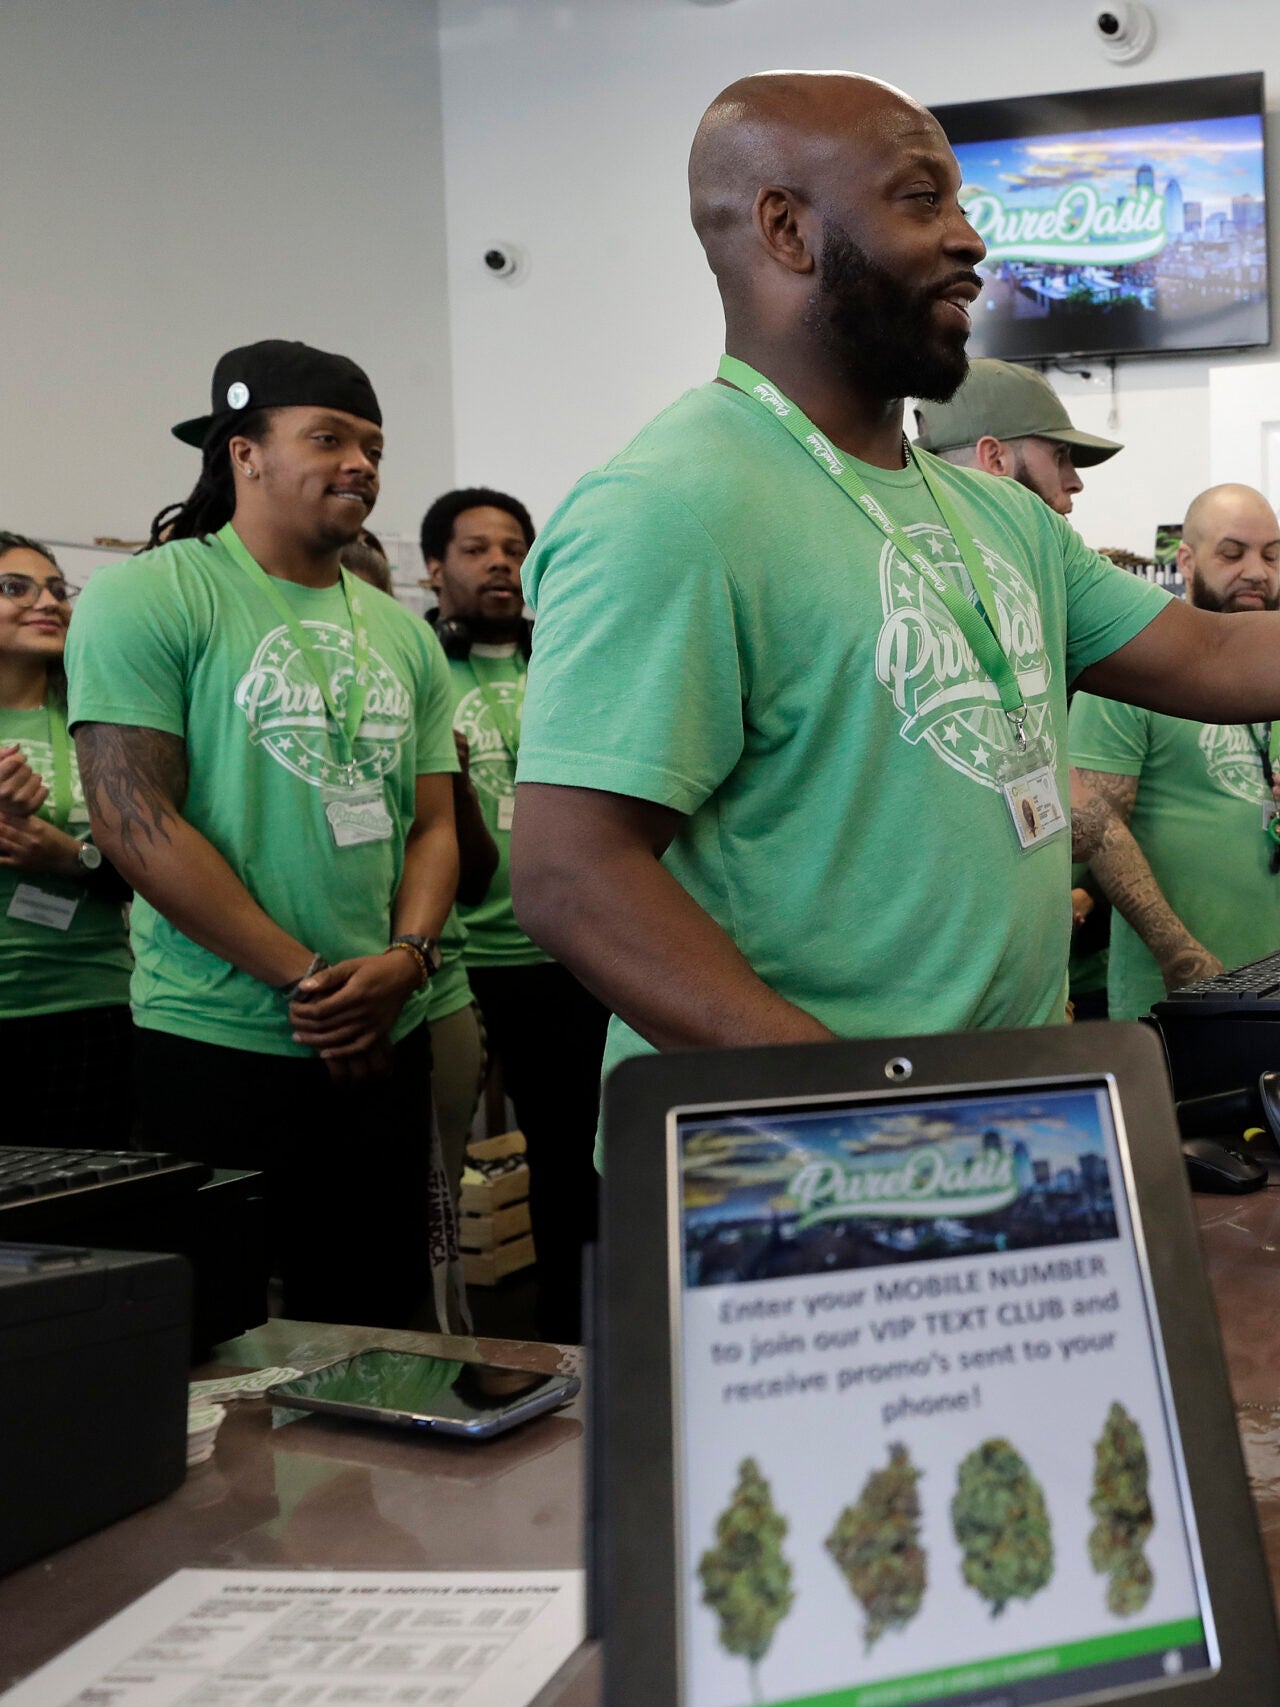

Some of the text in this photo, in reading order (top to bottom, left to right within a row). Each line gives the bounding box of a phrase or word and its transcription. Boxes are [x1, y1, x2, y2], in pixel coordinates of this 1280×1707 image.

[719, 1255, 1107, 1325] Enter your MOBILE NUMBER
[711, 1288, 1119, 1365] to join our VIP TEXT CLUB and
[722, 1372, 829, 1403] receive
[959, 1343, 1015, 1370] sent
[1023, 1340, 1051, 1361] to
[1056, 1331, 1116, 1364] your
